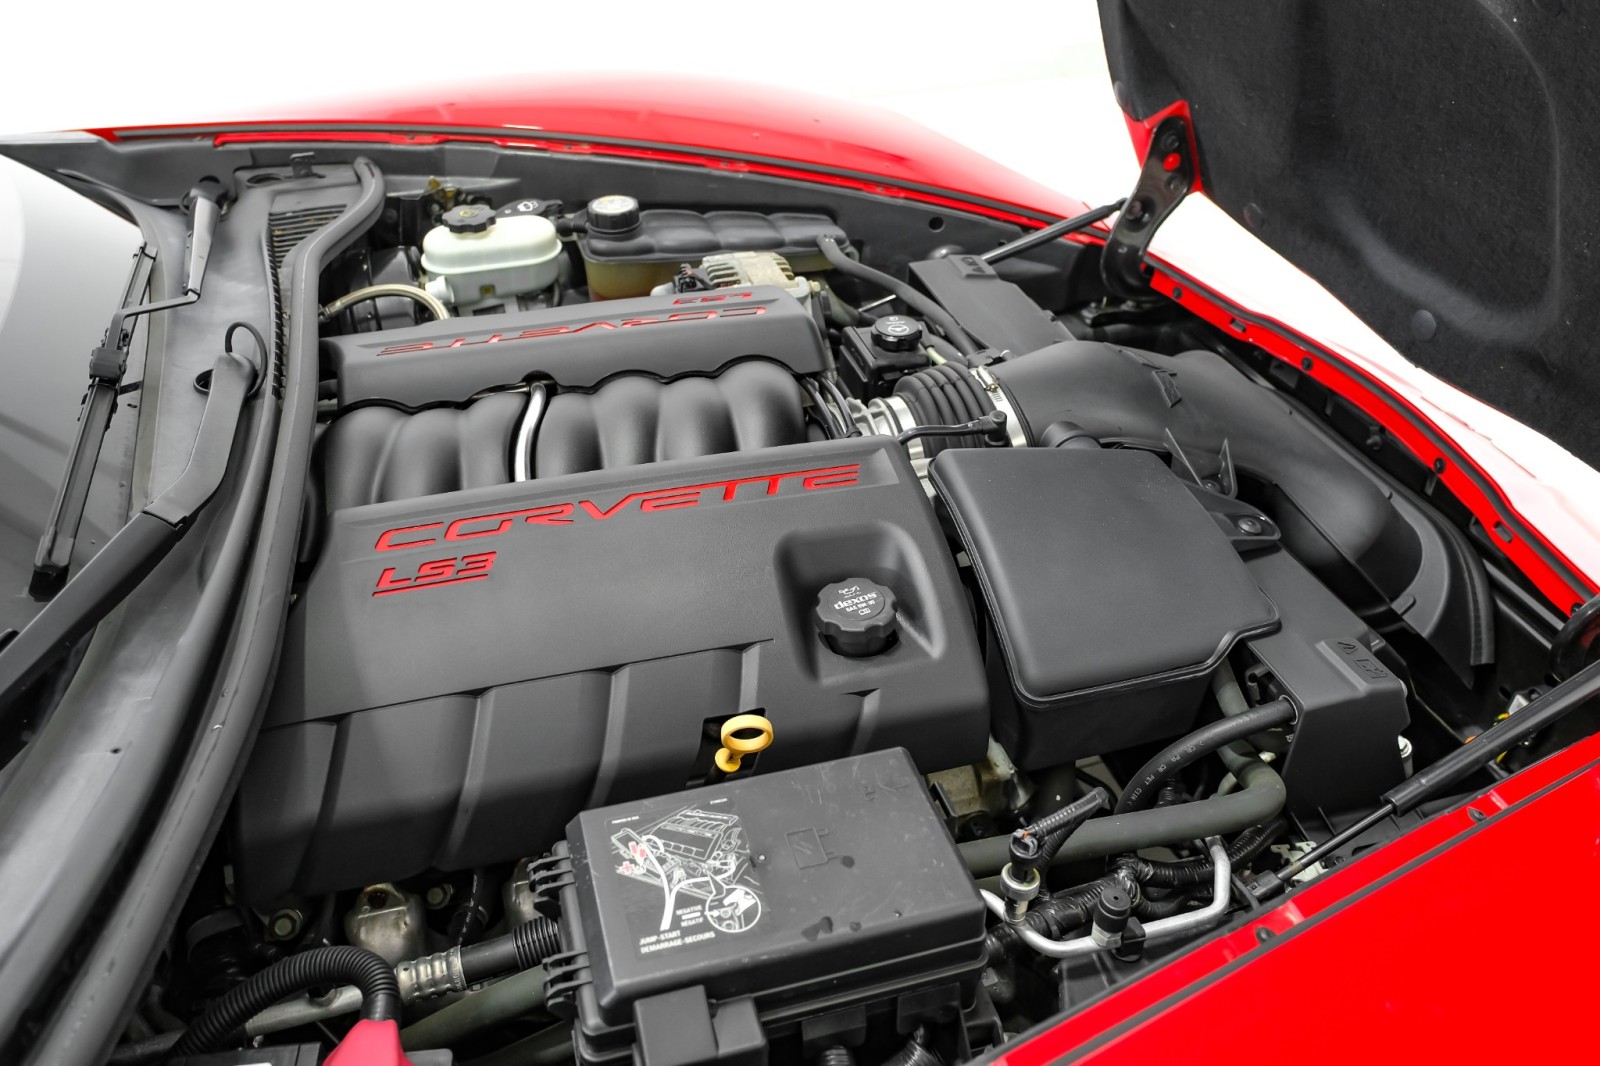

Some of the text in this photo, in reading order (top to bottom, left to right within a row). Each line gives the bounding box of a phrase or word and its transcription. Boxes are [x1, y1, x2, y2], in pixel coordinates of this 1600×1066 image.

[376, 306, 767, 356] CORVETTE
[374, 463, 861, 552] CORVETTE
[375, 550, 498, 589] LS3
[834, 592, 877, 610] dexos
[639, 930, 681, 946] JUMP-START
